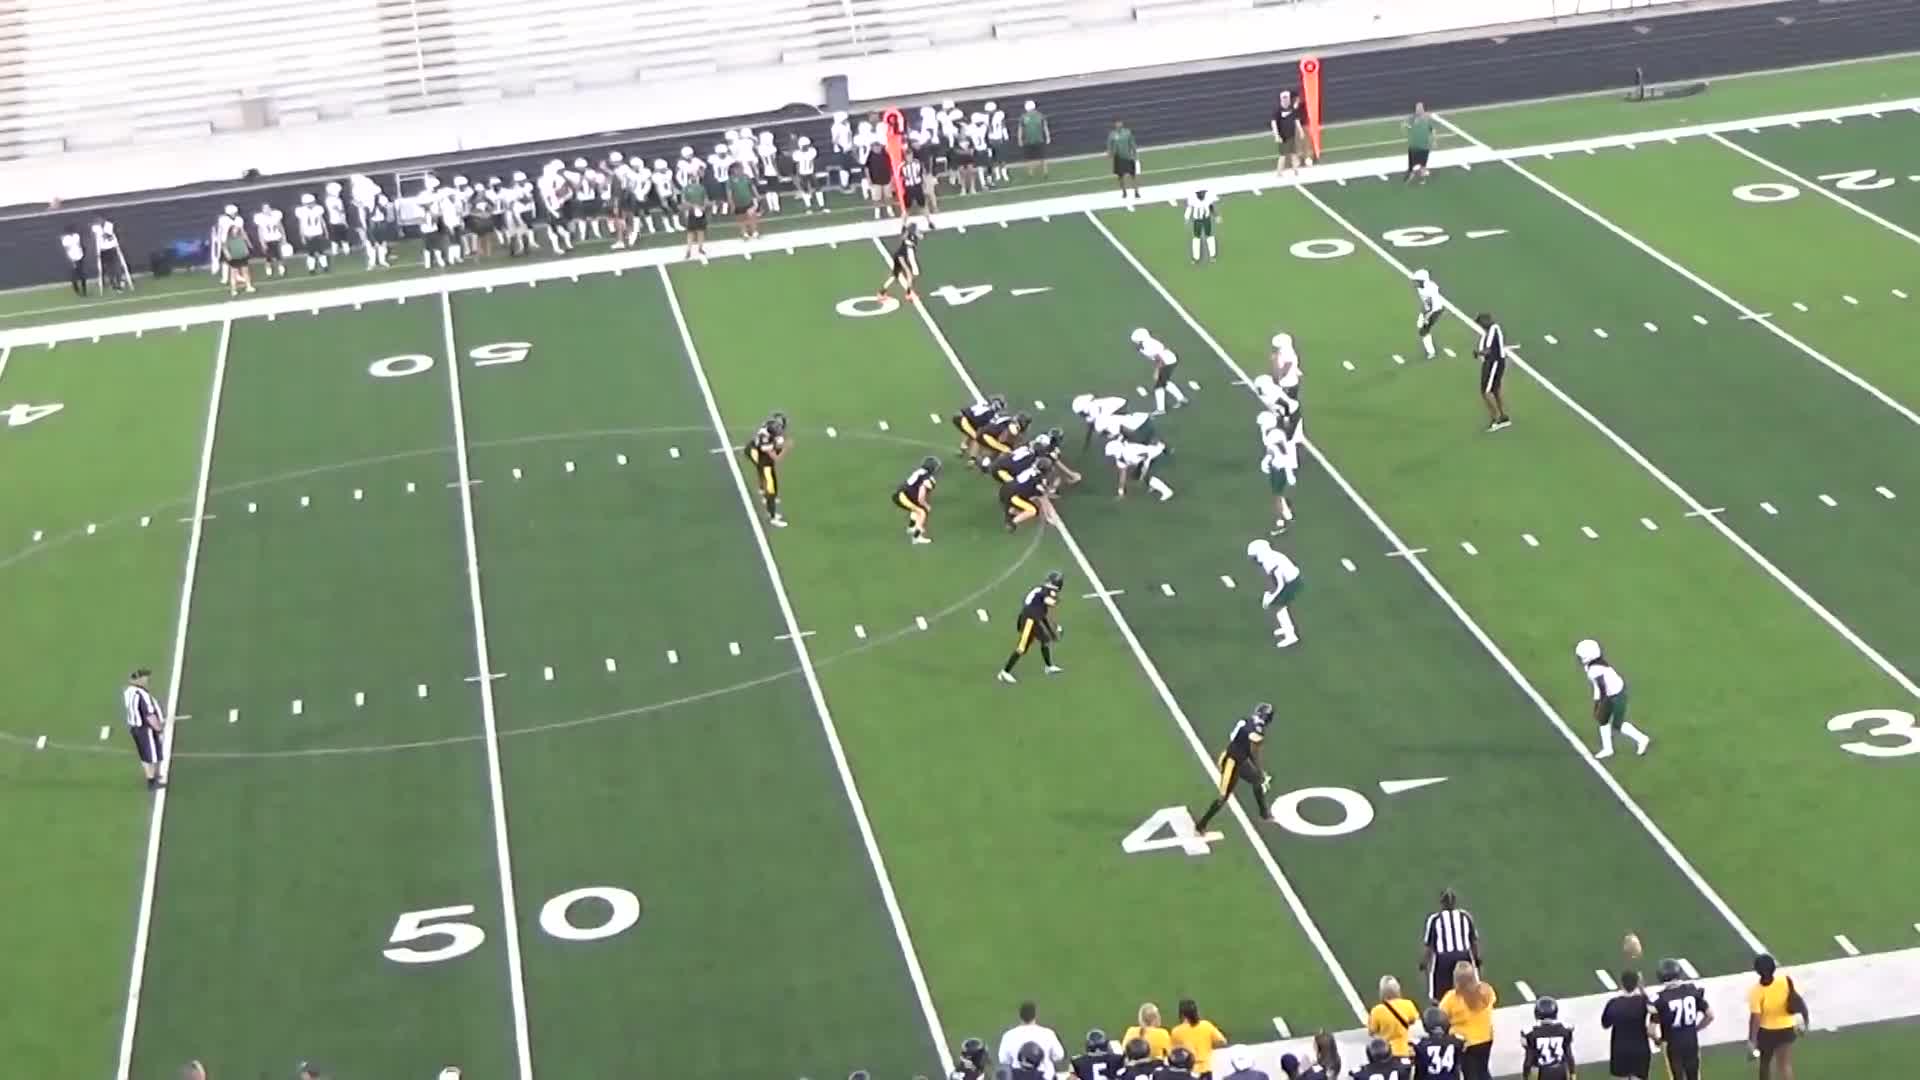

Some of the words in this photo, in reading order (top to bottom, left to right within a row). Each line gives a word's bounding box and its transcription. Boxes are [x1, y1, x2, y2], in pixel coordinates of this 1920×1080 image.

[1733, 169, 1896, 203] 20
[1290, 226, 1450, 259] 30
[836, 284, 993, 317] 40
[369, 342, 532, 377] 50
[1827, 709, 1920, 757] 3
[1122, 787, 1374, 856] 40
[384, 887, 640, 962] 50
[1668, 996, 1697, 1027] 78
[1427, 1044, 1455, 1074] 34
